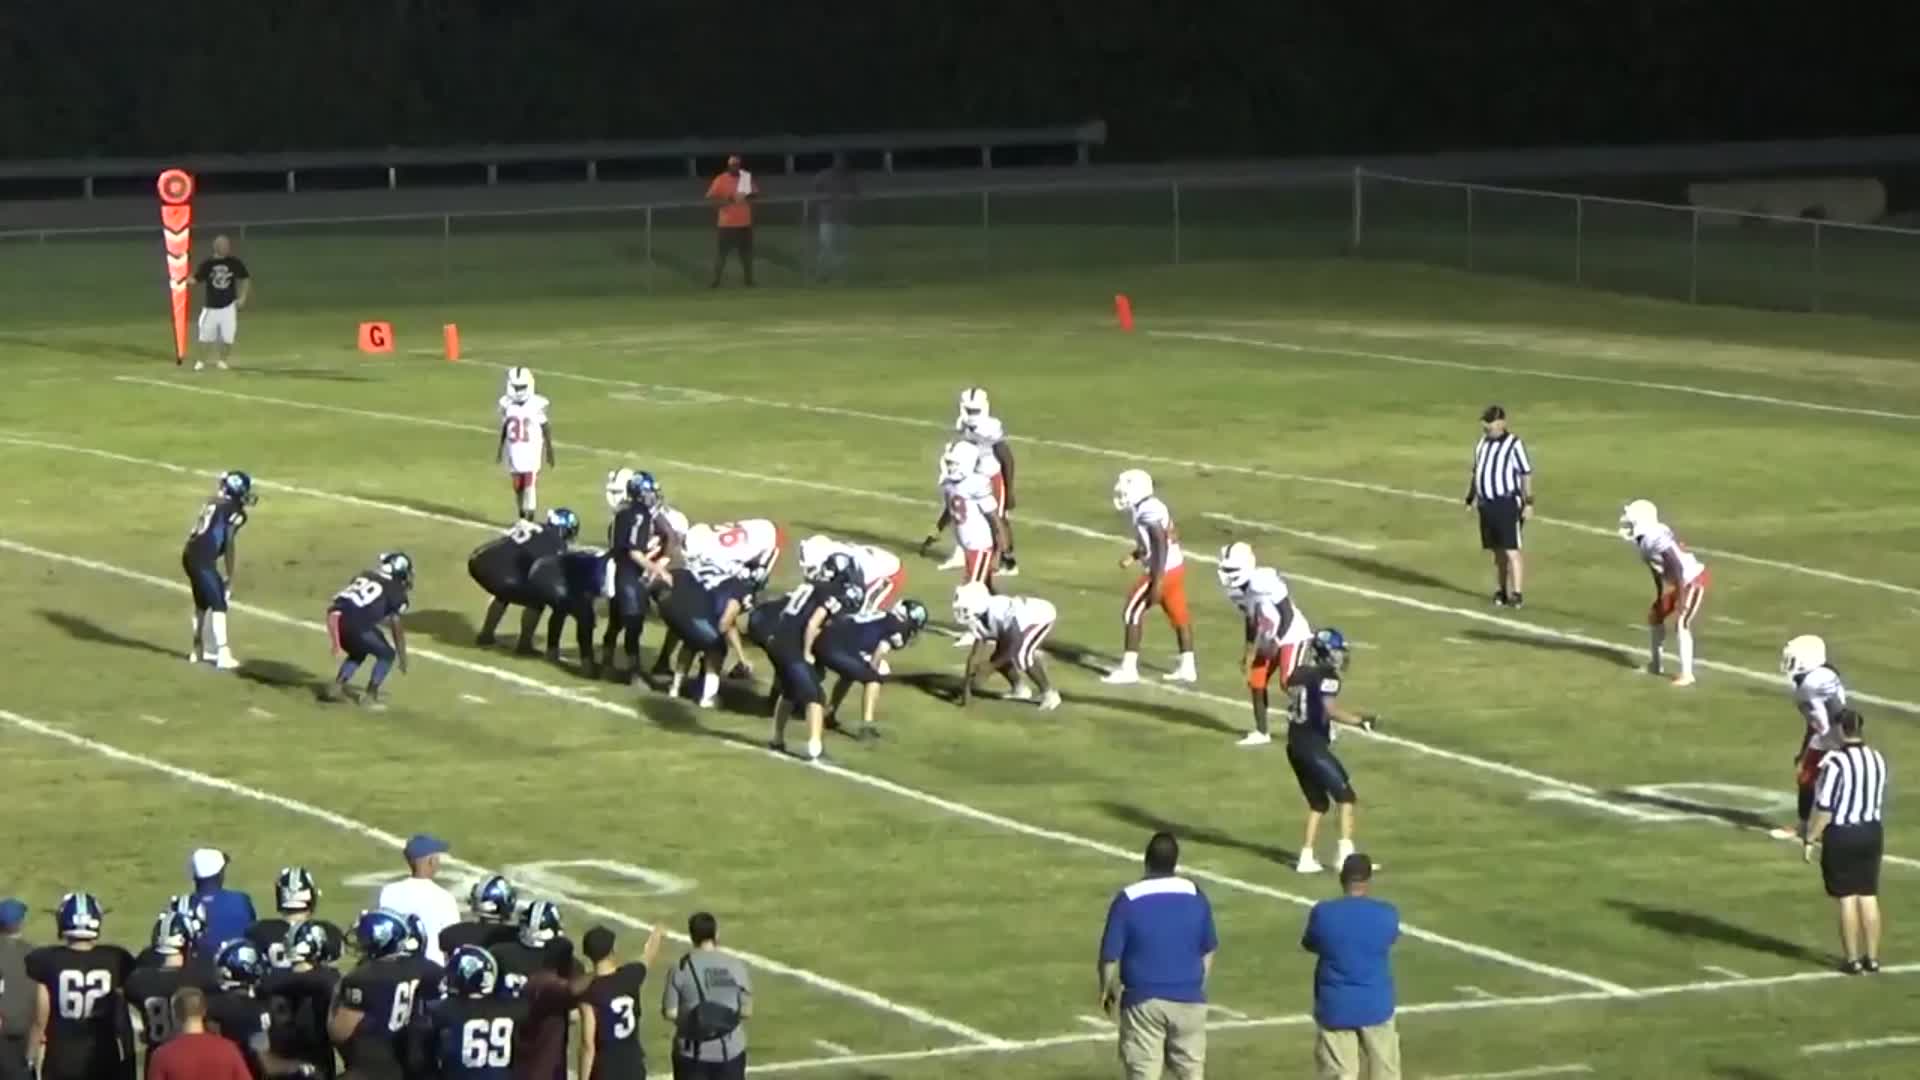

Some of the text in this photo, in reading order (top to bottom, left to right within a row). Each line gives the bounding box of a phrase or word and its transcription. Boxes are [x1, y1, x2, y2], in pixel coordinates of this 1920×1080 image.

[370, 325, 385, 348] G
[504, 415, 530, 444] 31
[59, 969, 112, 1020] 62
[610, 995, 637, 1030] 3
[461, 1016, 514, 1069] 69
